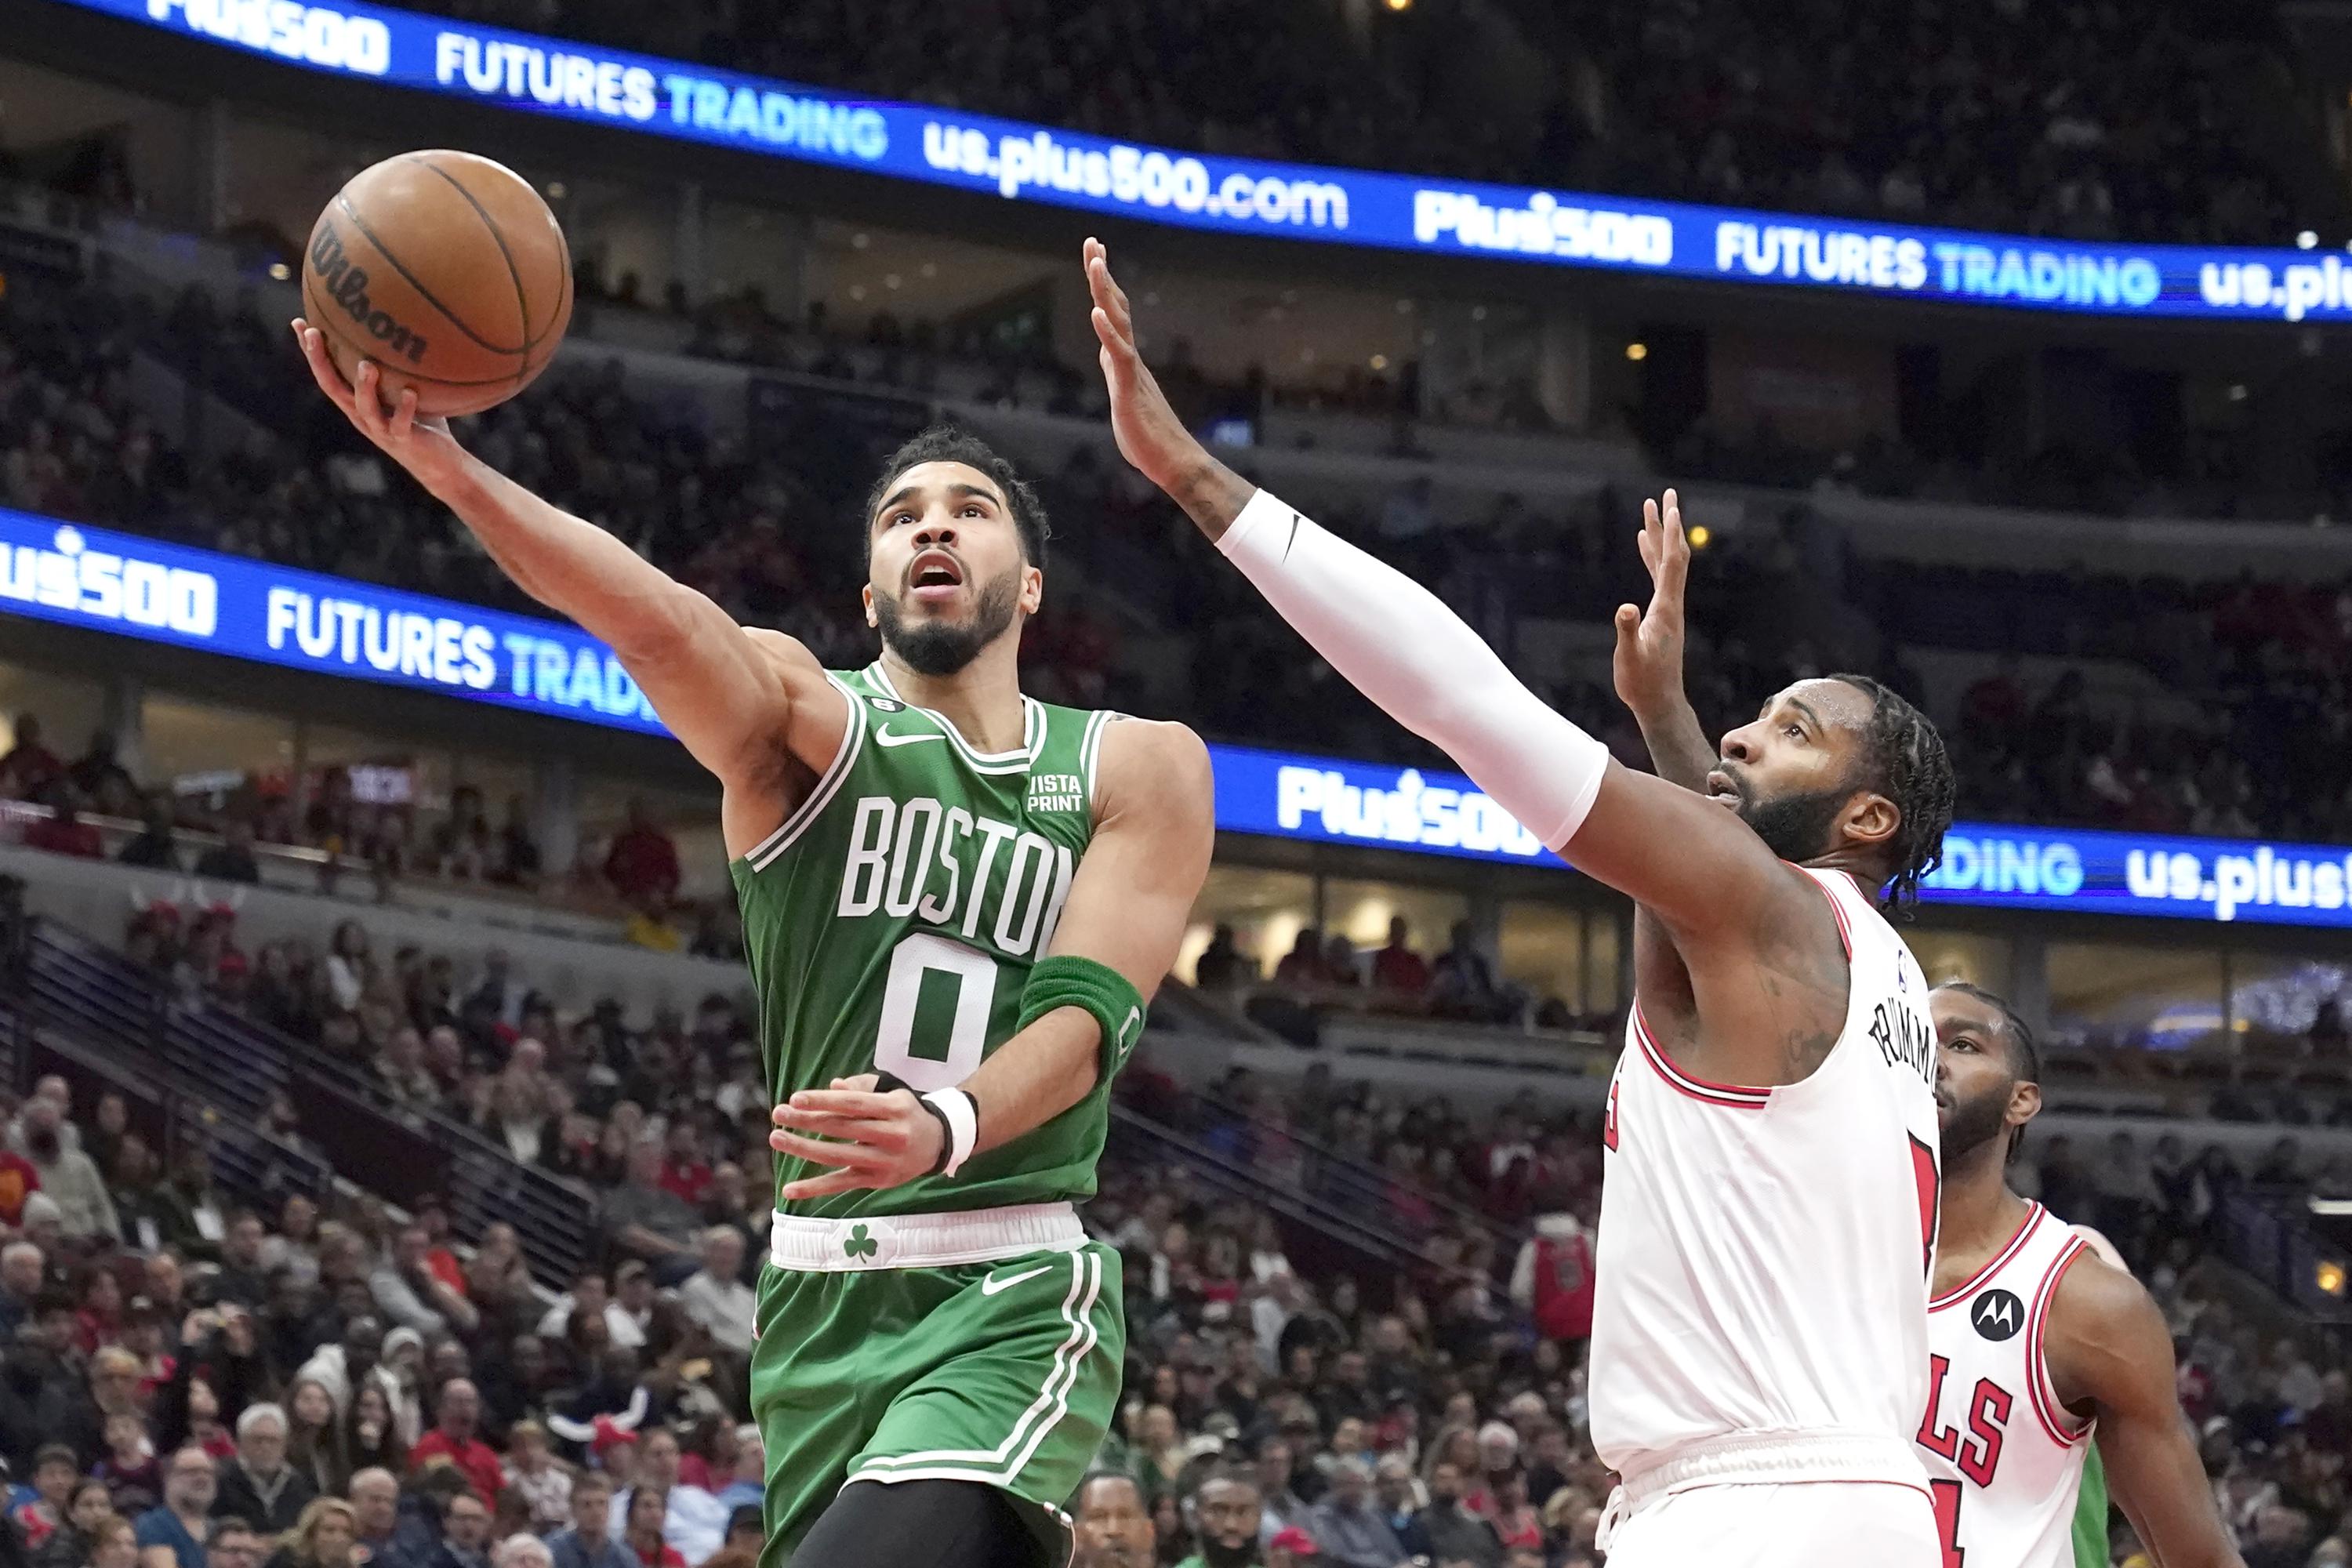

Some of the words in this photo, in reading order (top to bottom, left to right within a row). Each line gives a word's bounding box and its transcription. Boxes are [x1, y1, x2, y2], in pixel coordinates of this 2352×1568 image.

[436, 32, 655, 122] FUTURES
[662, 74, 889, 160] TRADING
[923, 122, 1349, 229] us.plus500.com
[1413, 189, 1674, 265] Plus500
[1715, 220, 1928, 289] FUTURES
[1932, 241, 2161, 308] TRADING
[311, 220, 426, 365] Wilson
[267, 584, 496, 690] FUTURES
[1027, 794, 1083, 812] PRINT
[2125, 846, 2352, 920] us.plus
[1868, 997, 1939, 1099] RUMM
